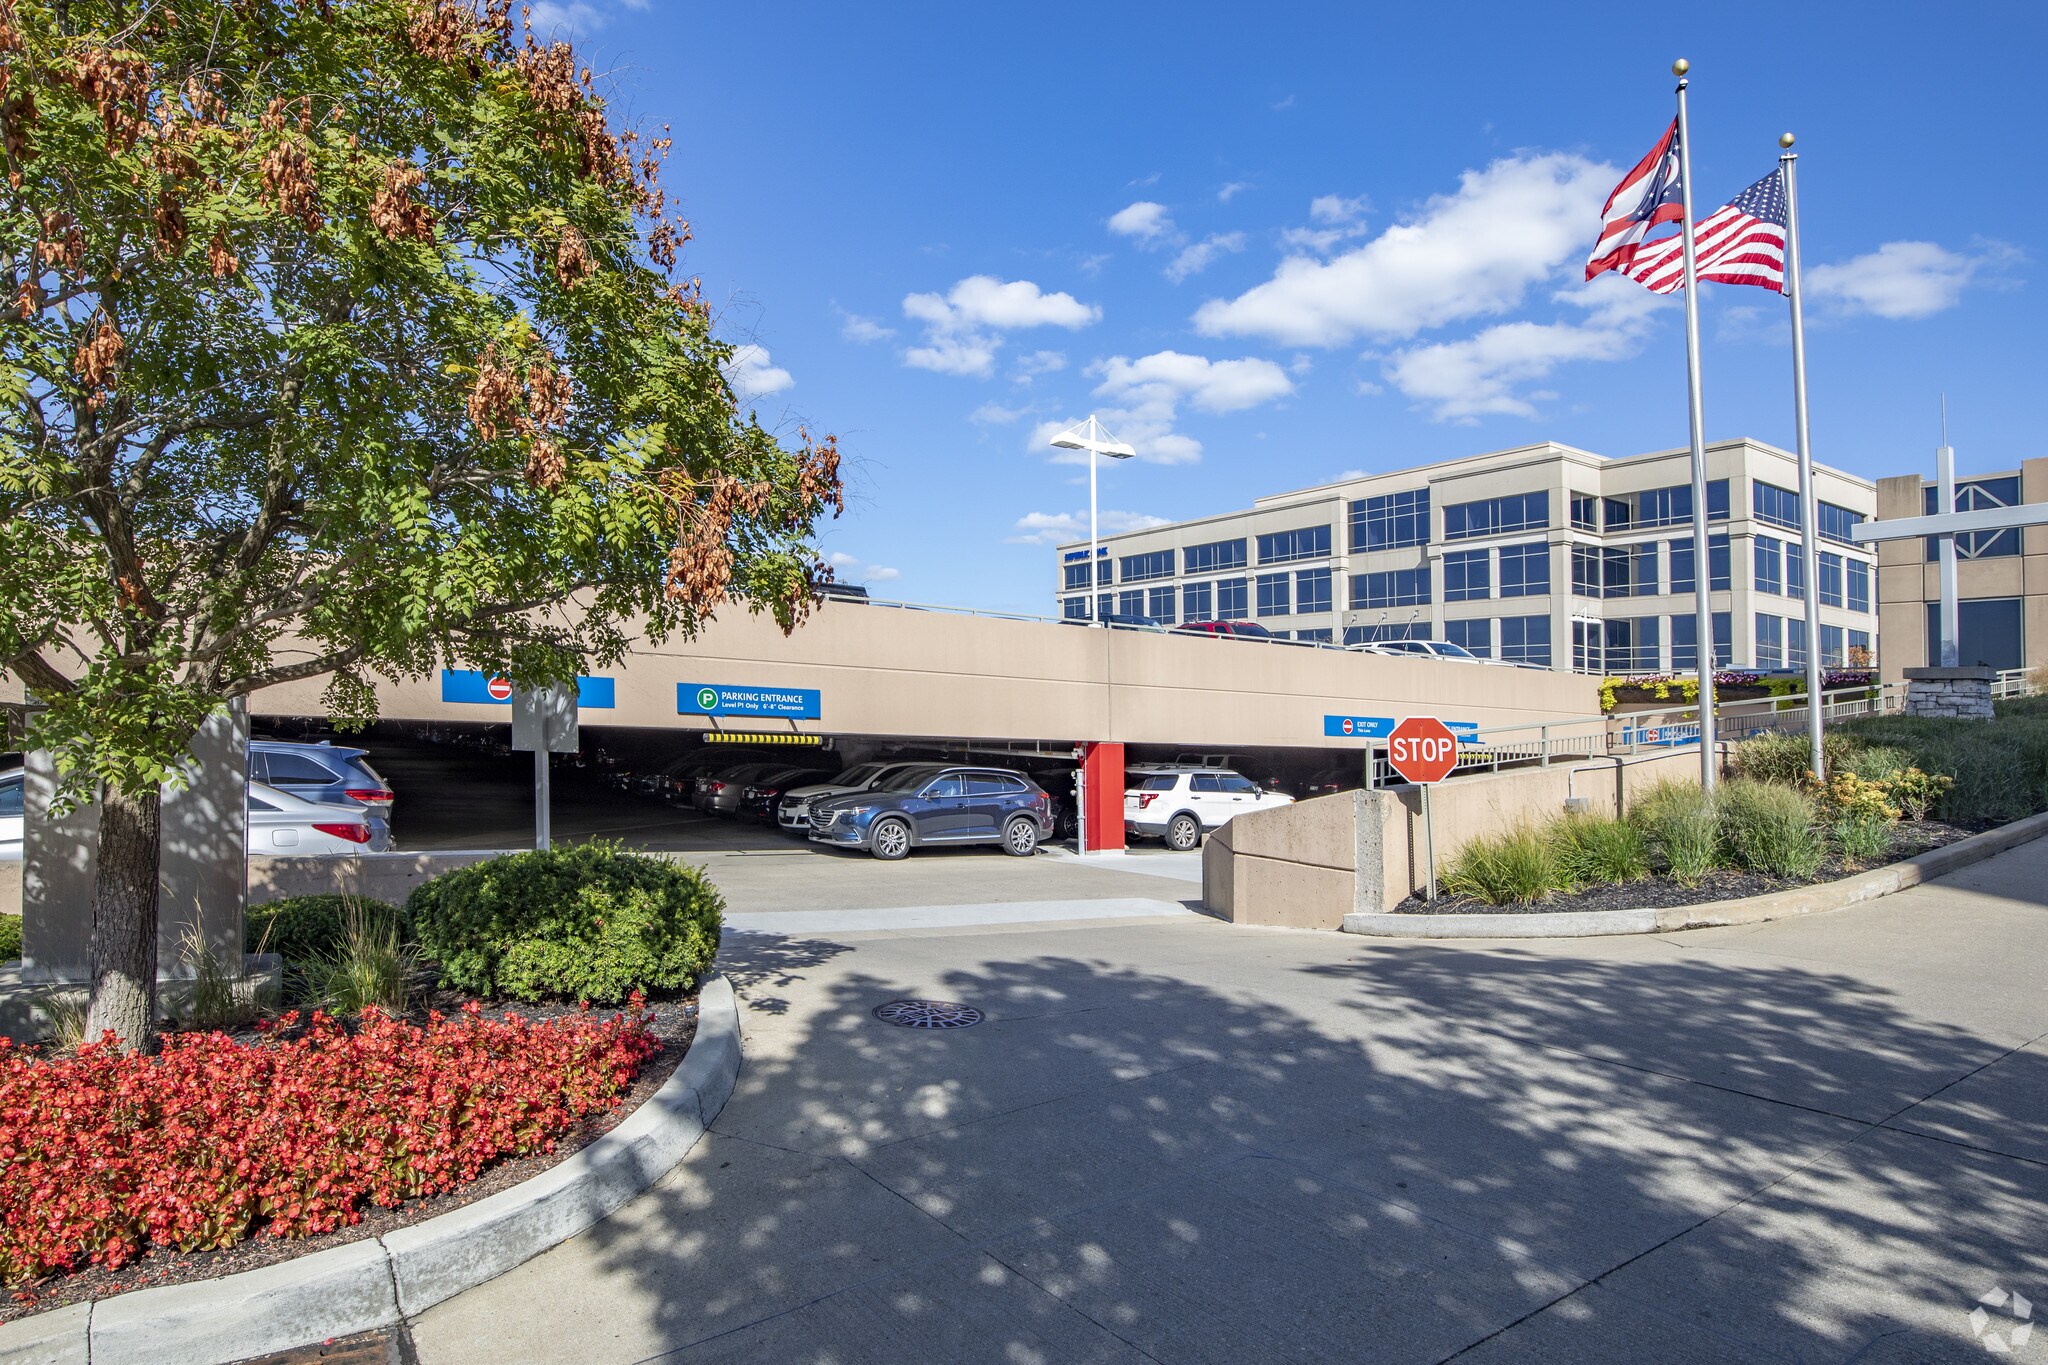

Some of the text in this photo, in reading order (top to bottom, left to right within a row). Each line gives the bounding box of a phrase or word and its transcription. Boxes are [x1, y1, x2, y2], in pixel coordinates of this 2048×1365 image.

[703, 693, 713, 705] P
[721, 691, 803, 703] PARKING ENTRANCE
[1393, 737, 1453, 762] STOP
